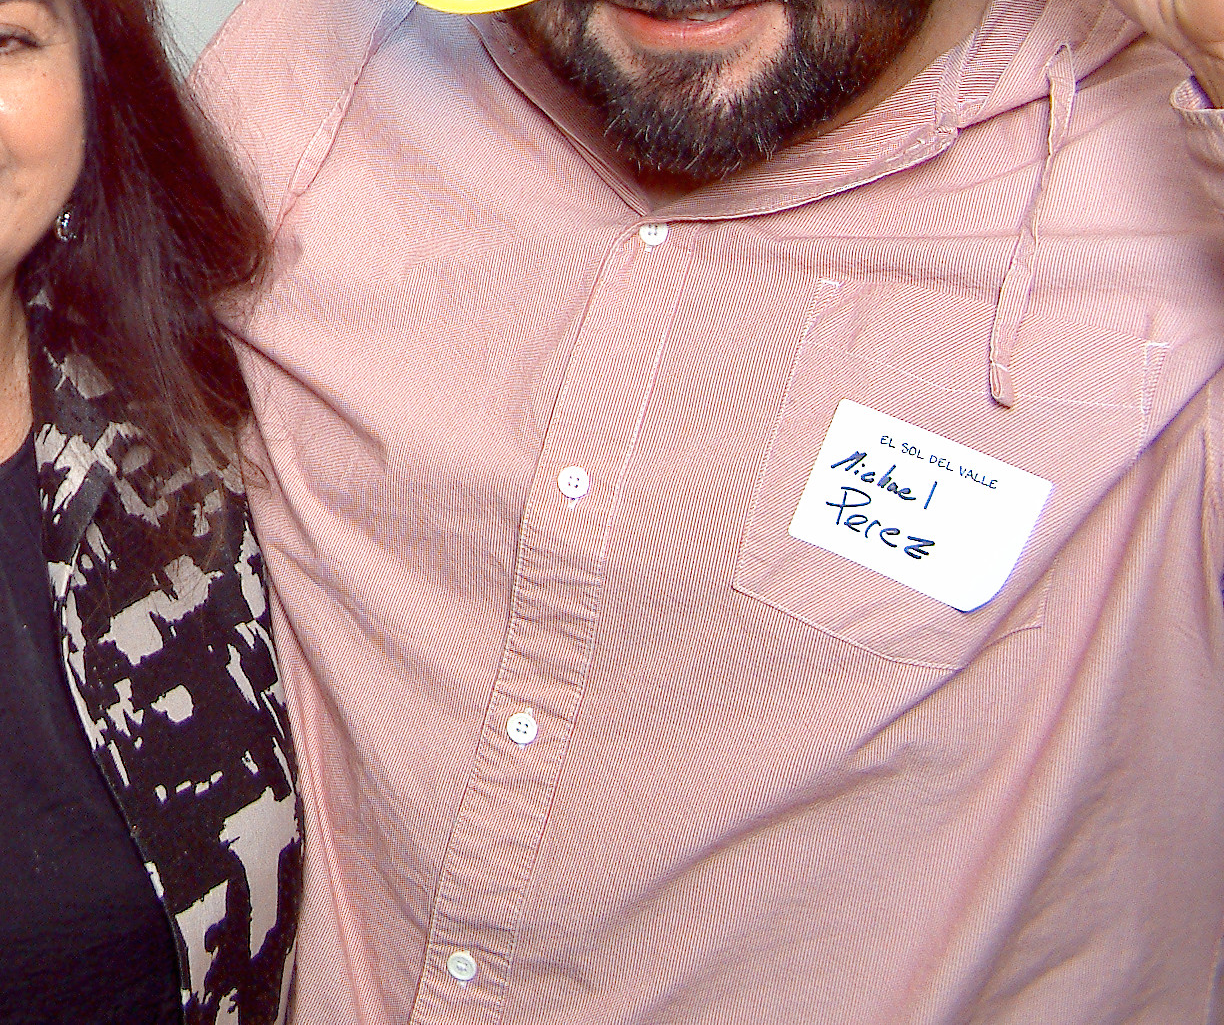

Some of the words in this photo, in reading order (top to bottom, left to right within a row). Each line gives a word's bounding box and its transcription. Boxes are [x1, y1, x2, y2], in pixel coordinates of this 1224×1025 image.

[879, 435, 896, 449] EL
[901, 442, 925, 460] SOL
[928, 454, 954, 472] DEL
[959, 465, 999, 490] VALLE
[825, 486, 936, 560] Perez
